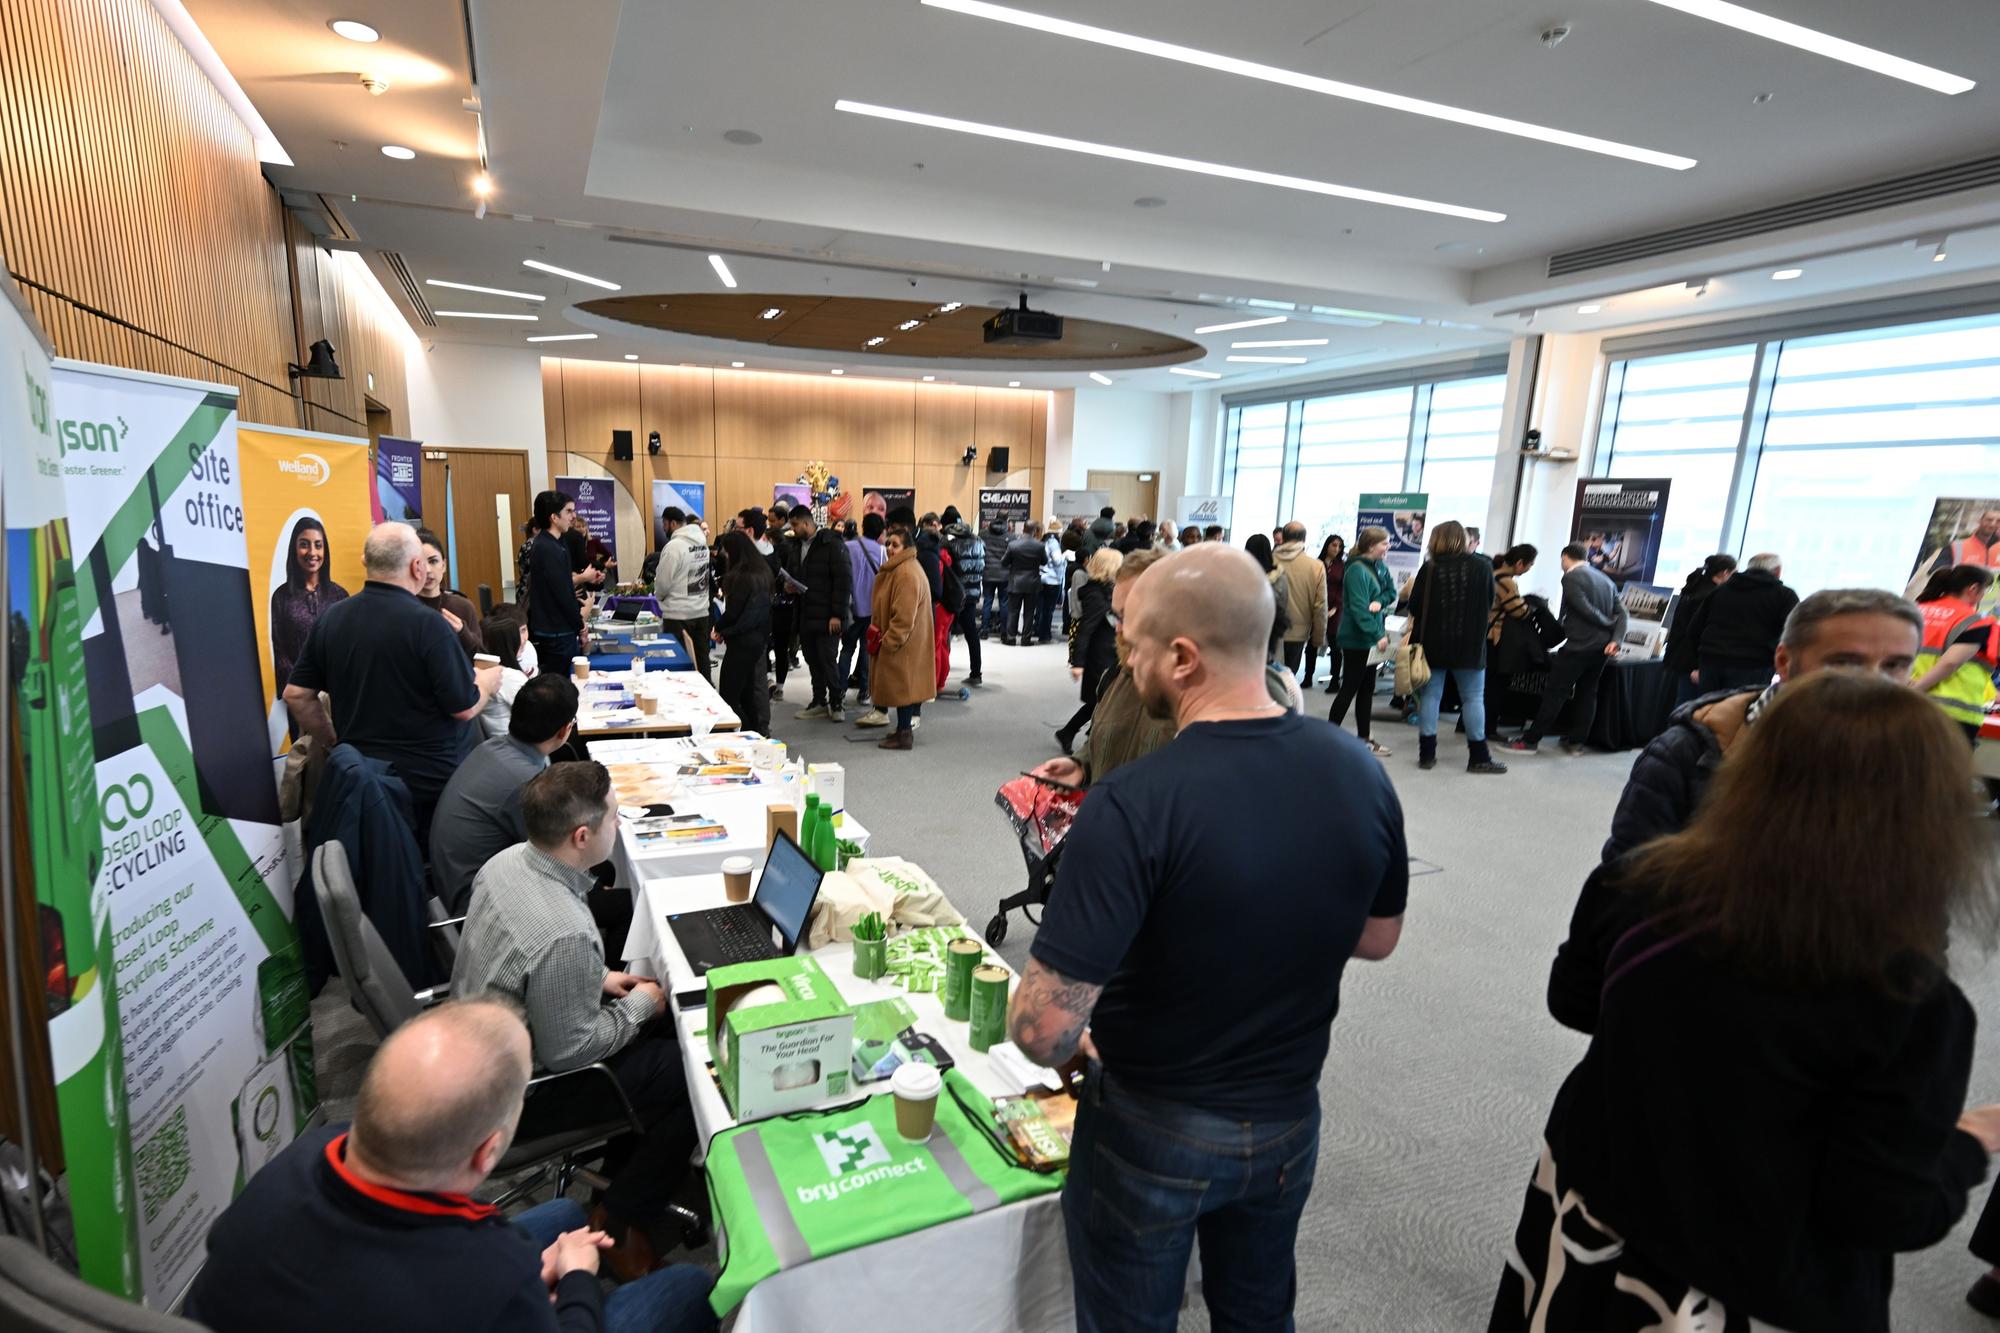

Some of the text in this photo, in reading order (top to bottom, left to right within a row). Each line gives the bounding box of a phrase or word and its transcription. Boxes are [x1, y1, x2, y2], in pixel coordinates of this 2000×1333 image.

[188, 442, 230, 485] Site
[278, 459, 319, 475] Welland
[185, 491, 244, 534] office
[144, 809, 183, 842] LOOP
[174, 883, 195, 905] our
[148, 919, 180, 949] Loop
[169, 917, 215, 959] Scheme
[154, 963, 189, 999] created
[197, 934, 228, 965] solution
[151, 978, 197, 1025] protection
[137, 1026, 162, 1055] same
[163, 995, 199, 1034] product
[761, 1034, 834, 1055] The Guardian For
[776, 1045, 820, 1060] Your Head
